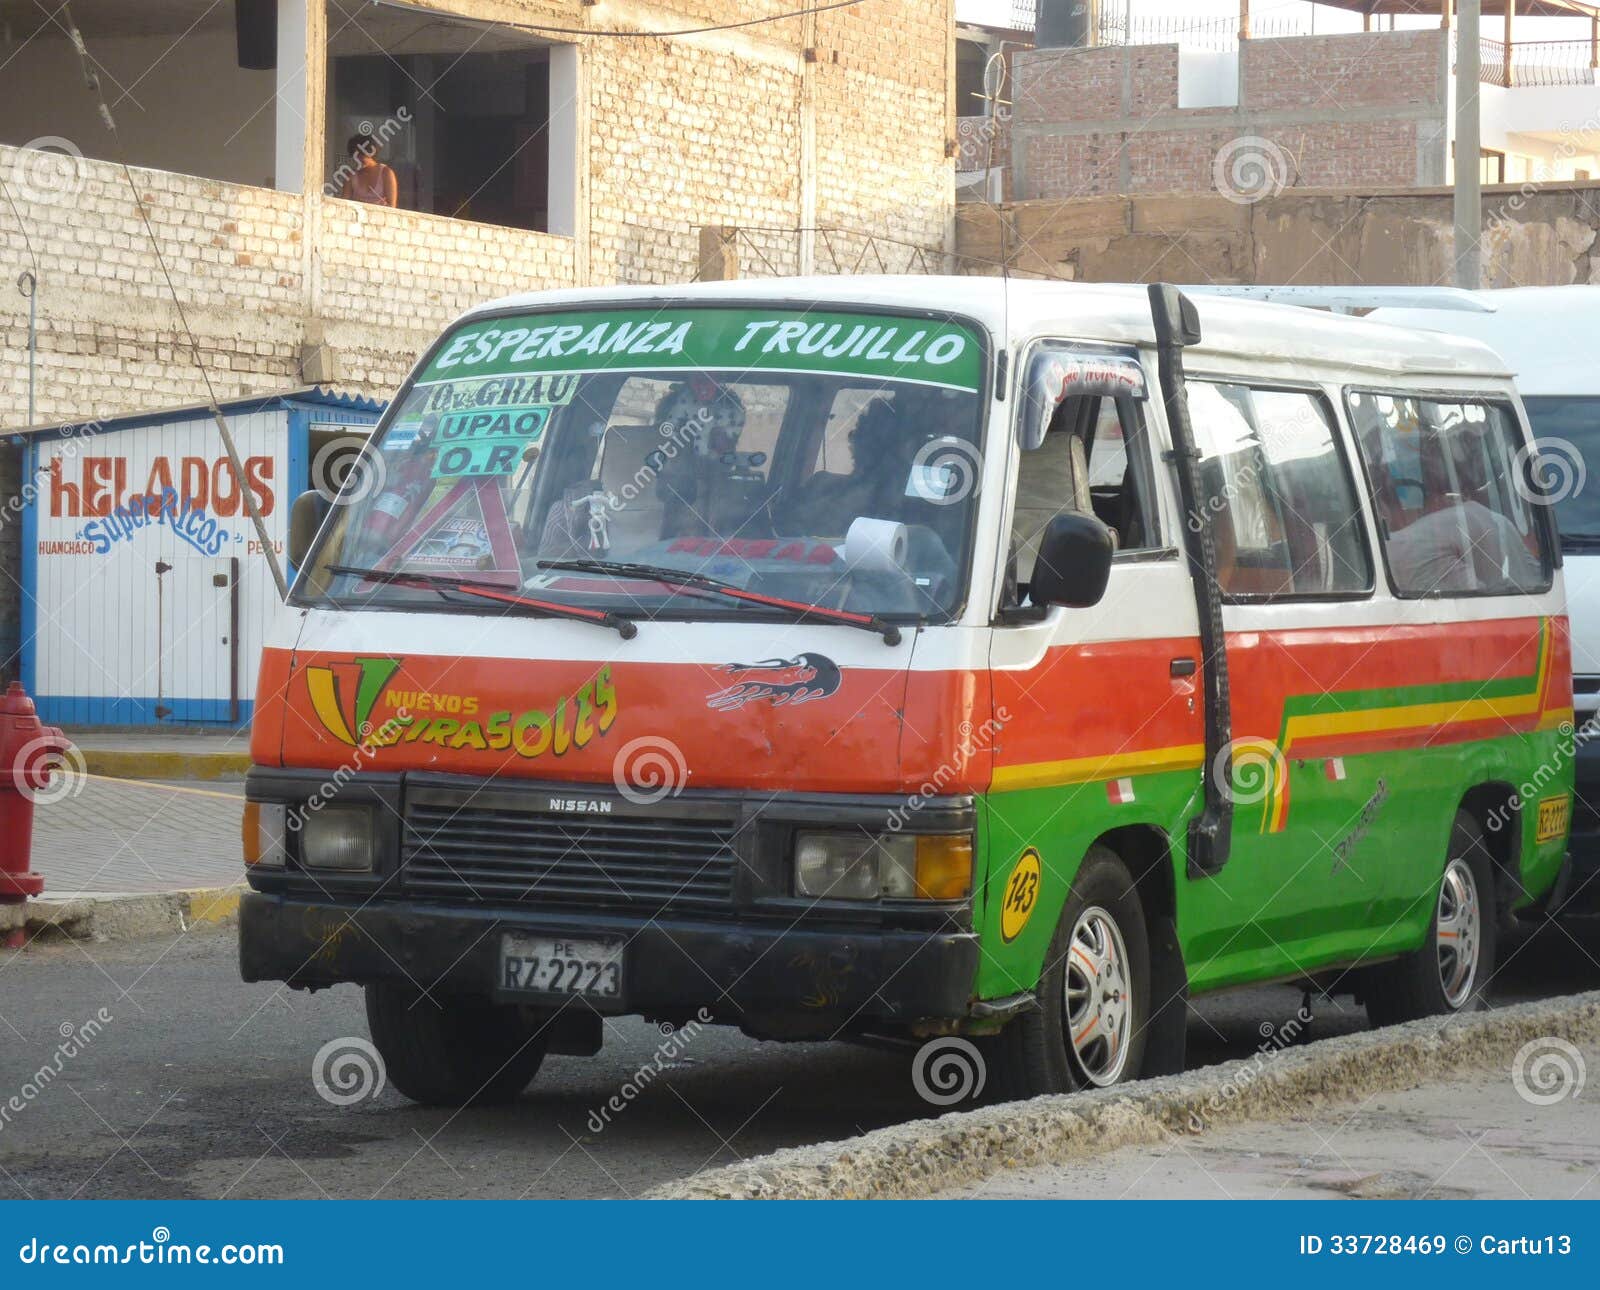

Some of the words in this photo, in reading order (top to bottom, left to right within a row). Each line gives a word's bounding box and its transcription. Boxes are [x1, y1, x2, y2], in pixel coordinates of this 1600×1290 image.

[436, 321, 692, 368] ESPERANZA
[735, 321, 965, 364] TRUJILLO
[443, 412, 542, 439] UPAO
[39, 541, 95, 555] HUANCHACO
[248, 540, 283, 555] PEU
[385, 688, 479, 715] NUEVOS
[550, 799, 612, 813] NISSAN
[1005, 870, 1037, 914] 143
[554, 943, 575, 957] PE
